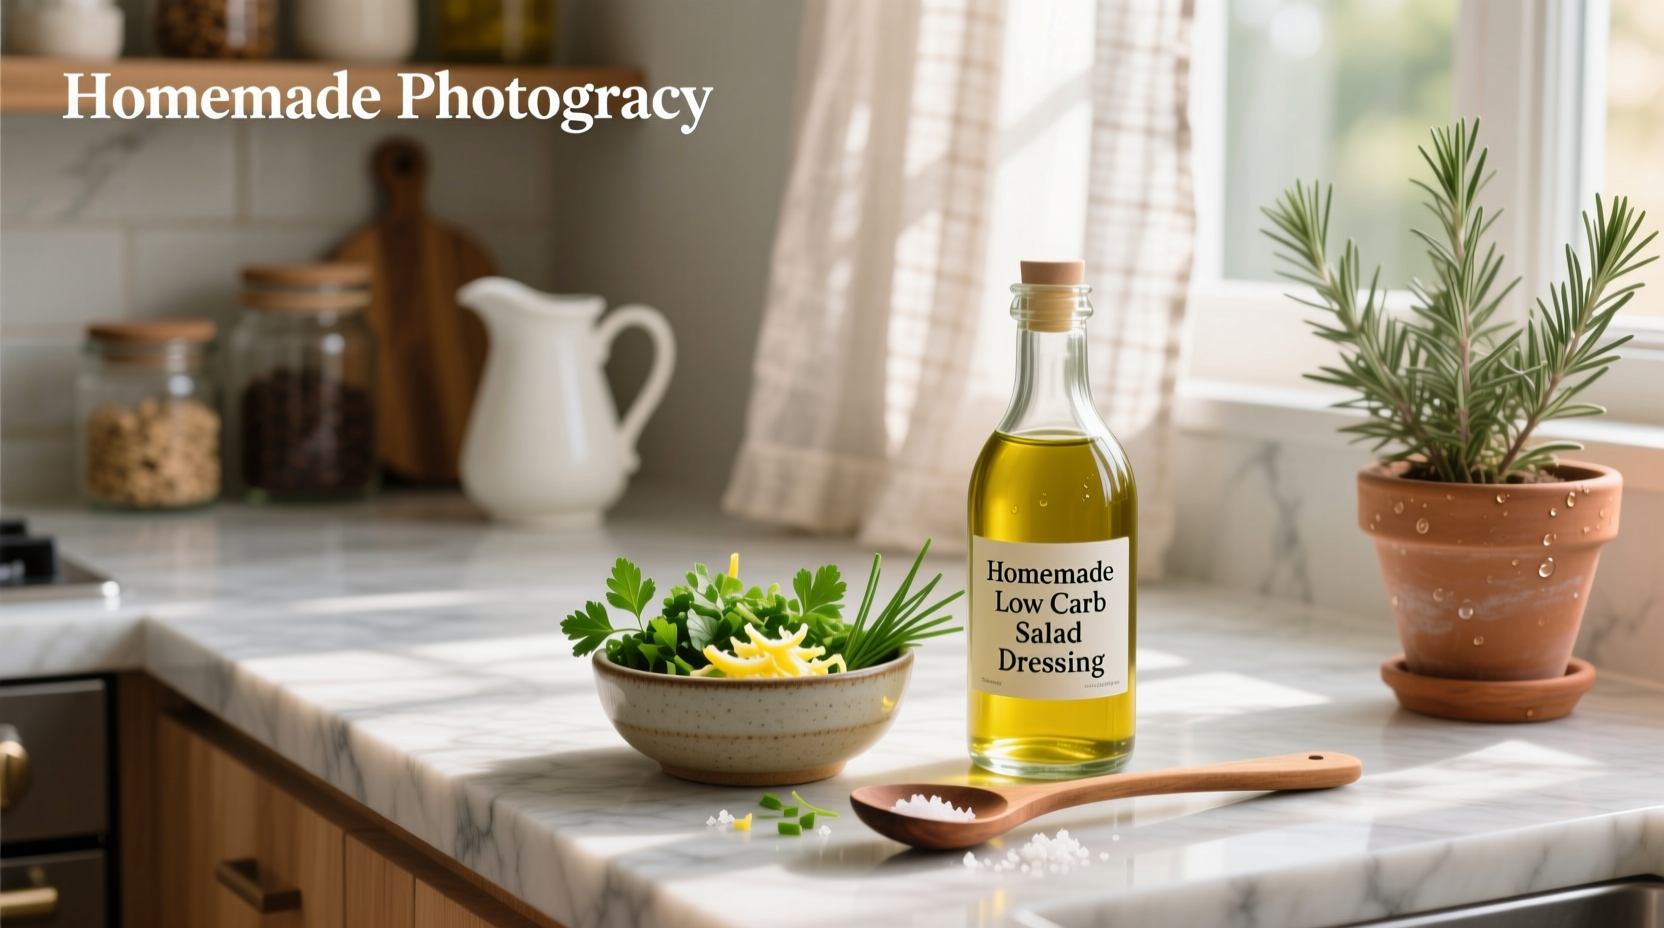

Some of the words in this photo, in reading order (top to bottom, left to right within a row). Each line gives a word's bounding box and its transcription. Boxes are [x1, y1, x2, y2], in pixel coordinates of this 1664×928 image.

[986, 559, 1114, 585] Homemade
[994, 590, 1043, 614] Low
[1050, 590, 1106, 615] Carb
[1015, 620, 1082, 644] Salad
[998, 647, 1106, 678] Dressing
